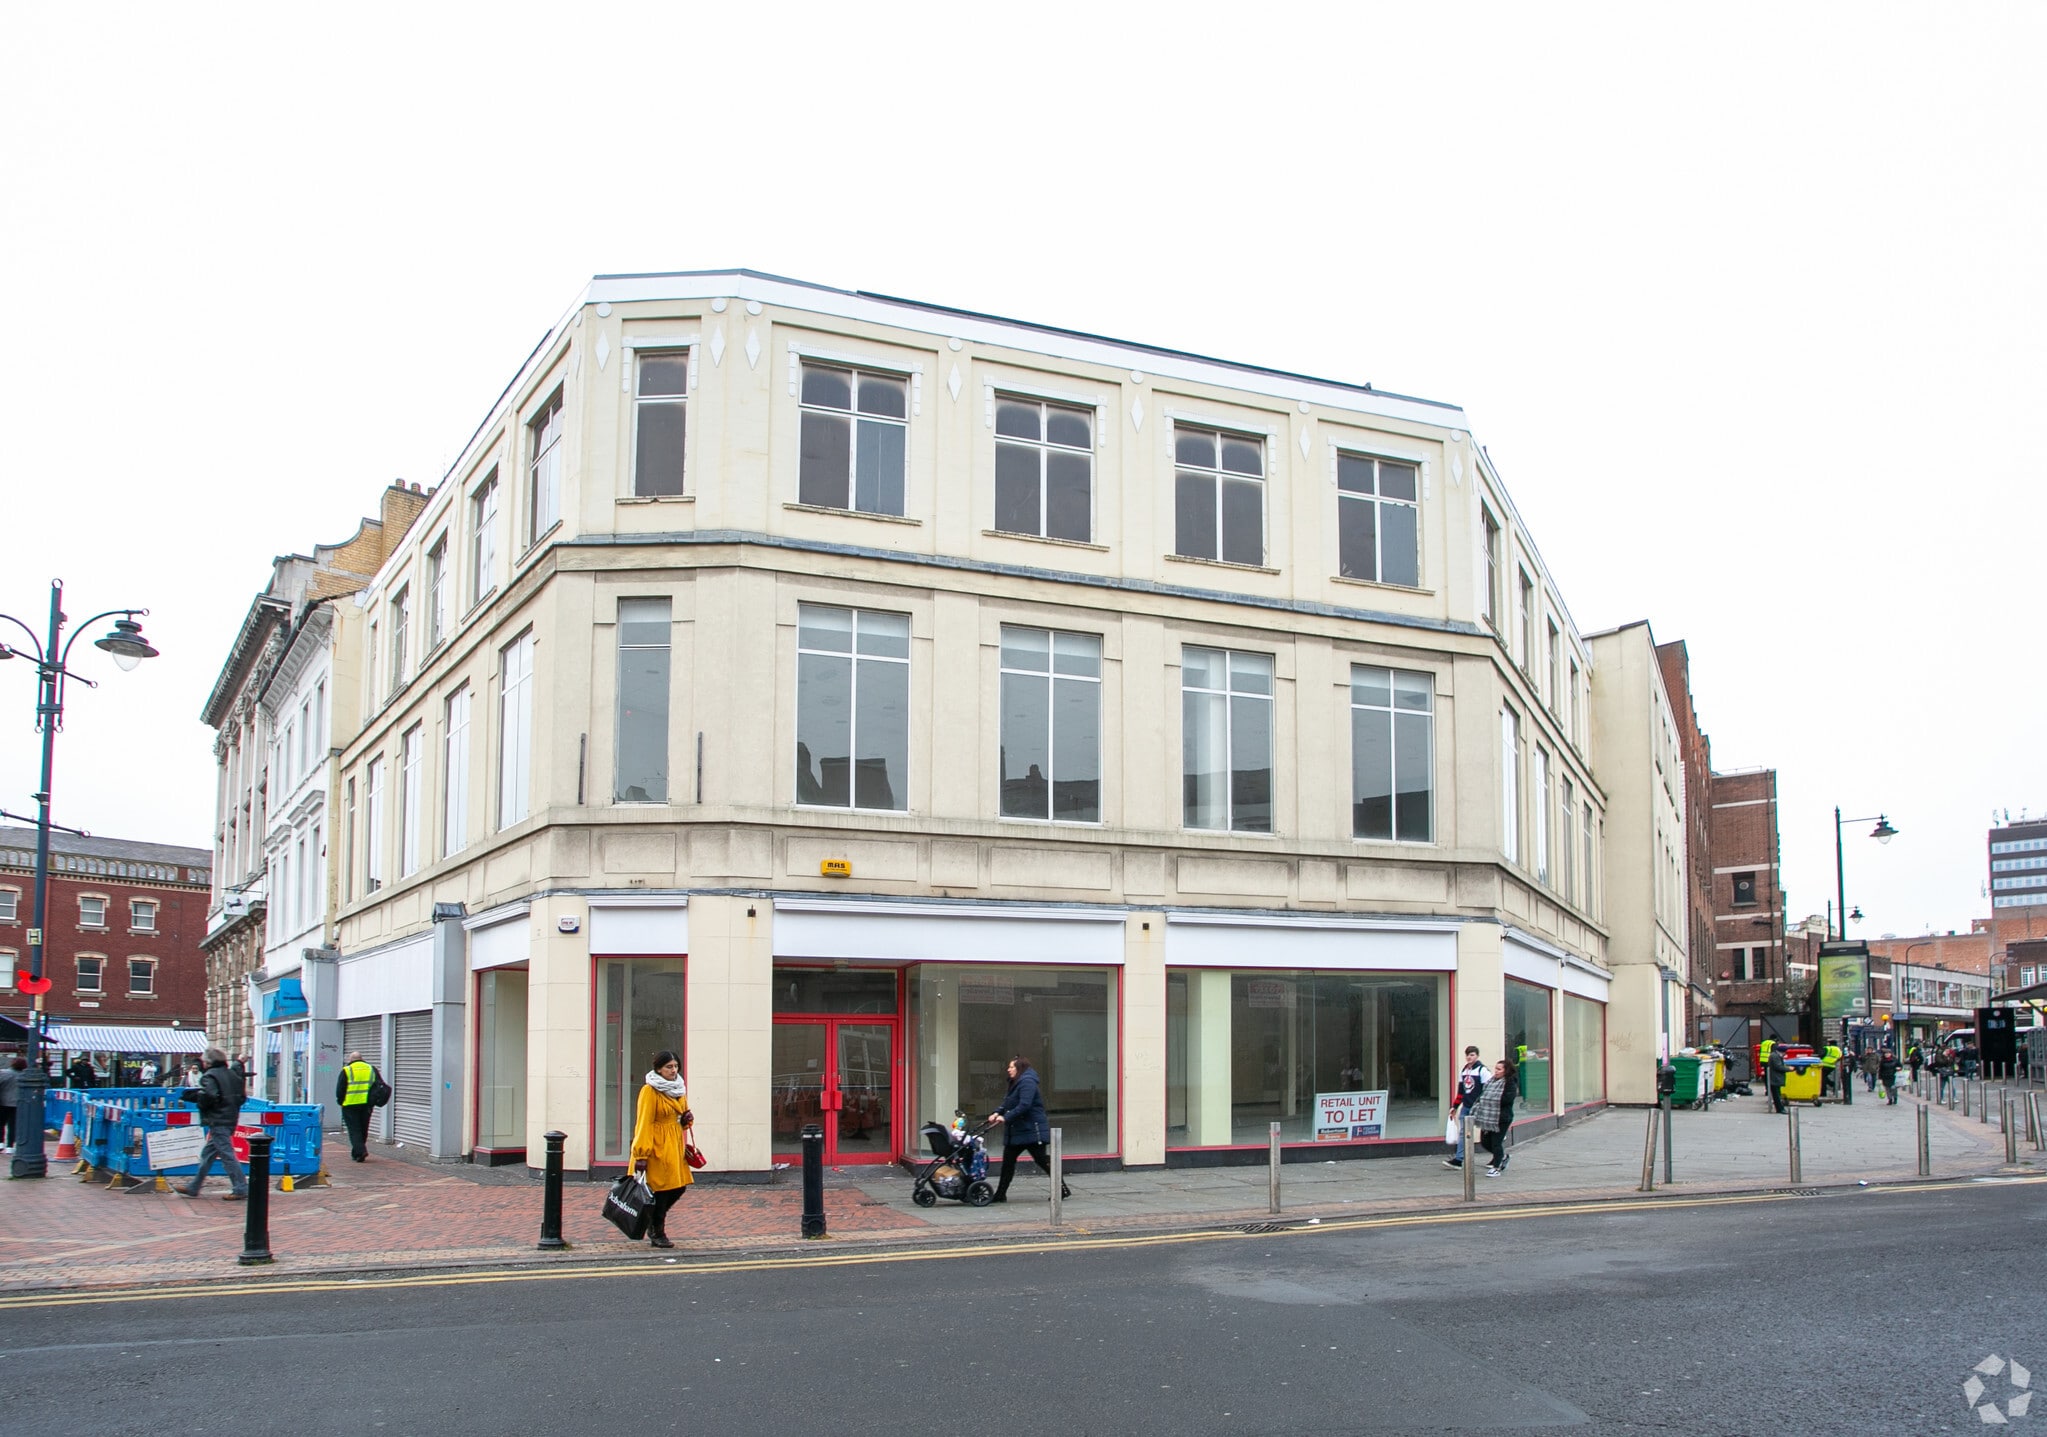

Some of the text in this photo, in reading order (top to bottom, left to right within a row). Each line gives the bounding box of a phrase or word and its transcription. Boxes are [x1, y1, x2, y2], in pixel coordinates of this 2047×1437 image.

[1321, 1096, 1381, 1108] RETAIL UNIT
[1325, 1108, 1376, 1123] TO LET
